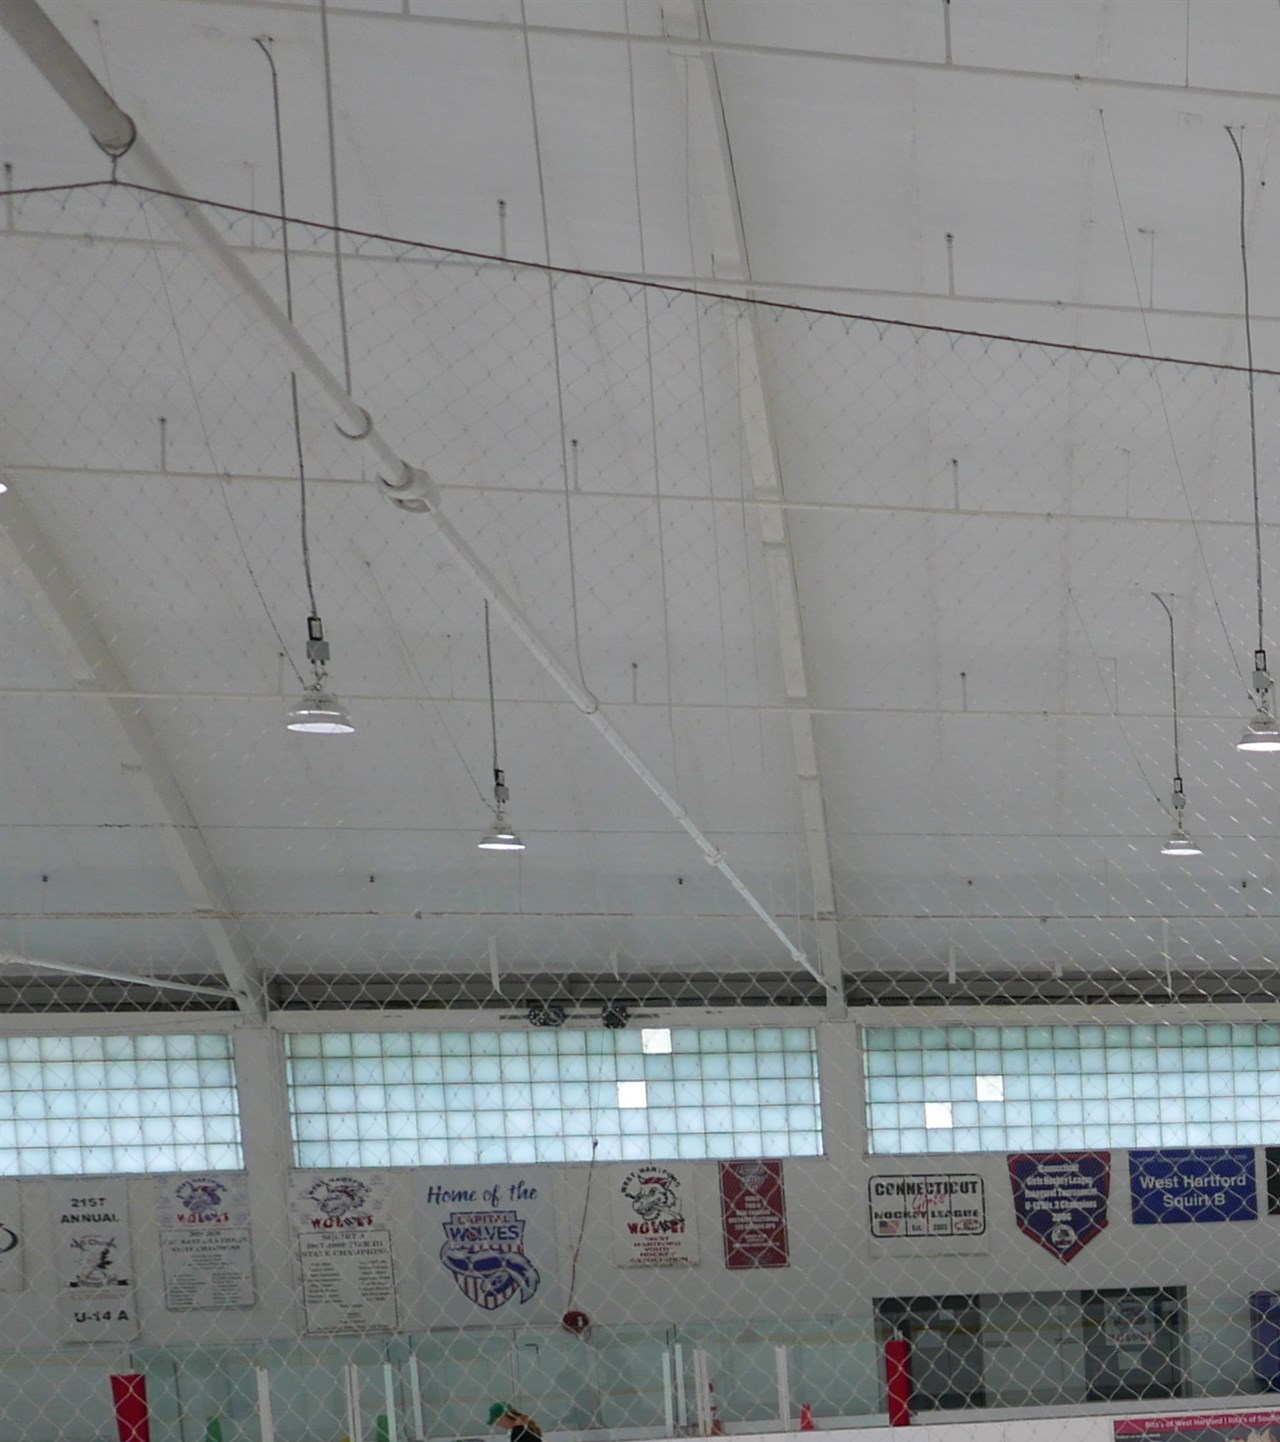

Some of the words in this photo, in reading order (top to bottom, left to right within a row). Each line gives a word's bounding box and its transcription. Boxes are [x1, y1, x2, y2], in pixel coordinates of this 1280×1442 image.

[1139, 1175, 1180, 1189] West
[1184, 1174, 1247, 1187] Hartford
[427, 1185, 478, 1206] Home
[483, 1184, 503, 1209] of
[508, 1180, 538, 1202] the
[875, 1182, 979, 1196] CONNECTICUT
[1163, 1194, 1210, 1209] Squirt
[1215, 1193, 1226, 1205] B
[61, 1213, 119, 1224] ANNUAL
[456, 1214, 512, 1227] CAPITAL
[874, 1211, 929, 1219] HOCKEY
[931, 1210, 980, 1218] LEAGUE
[450, 1225, 521, 1242] WOLVES
[74, 1310, 112, 1323] U-14
[117, 1310, 129, 1321] A
[1175, 1418, 1193, 1428] West
